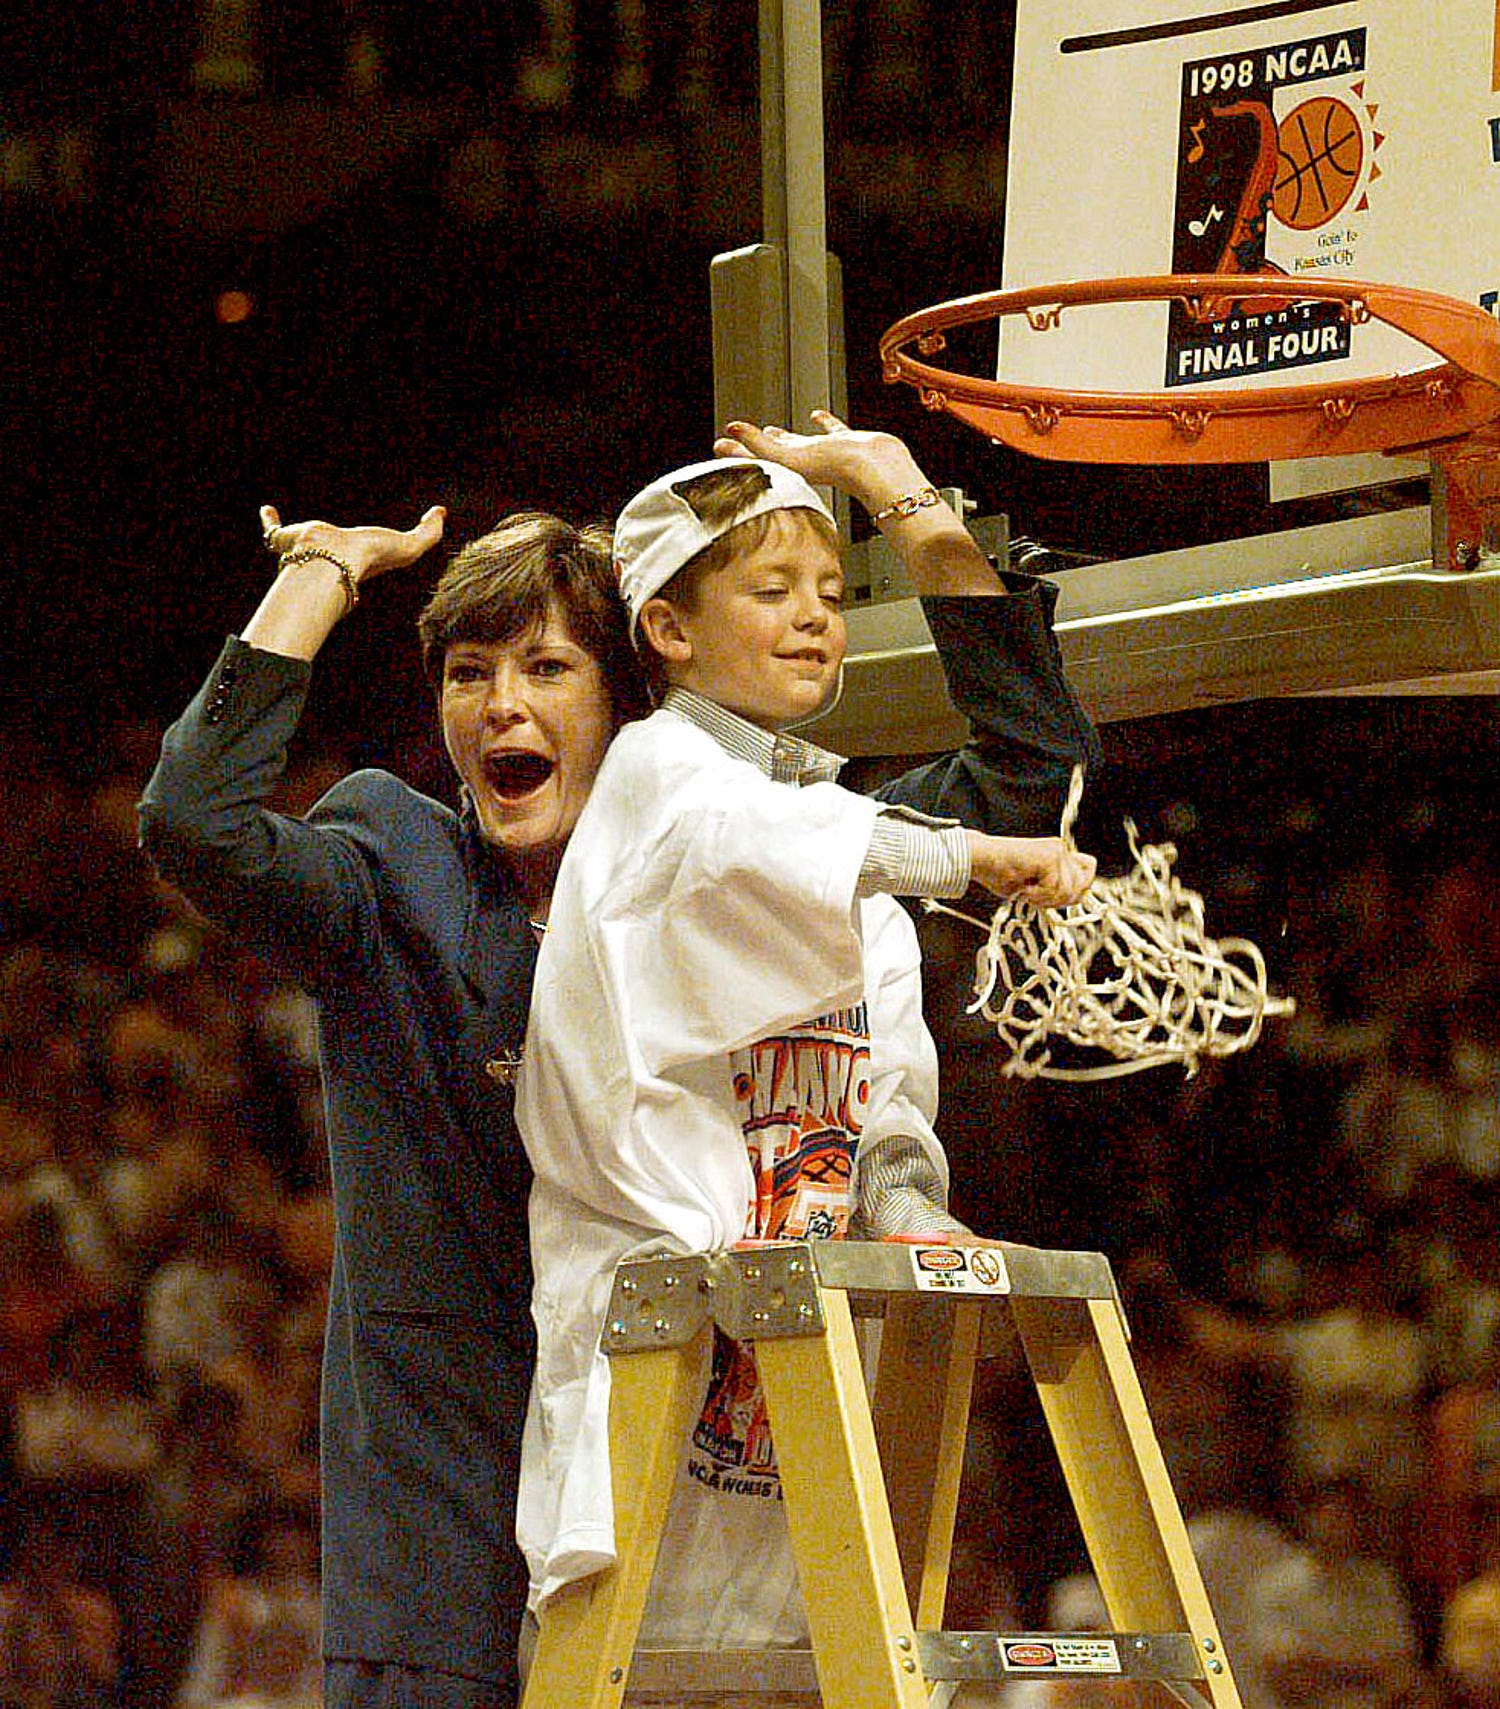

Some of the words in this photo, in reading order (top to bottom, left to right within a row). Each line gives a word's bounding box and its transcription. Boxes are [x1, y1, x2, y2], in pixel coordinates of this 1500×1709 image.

[1190, 59, 1254, 97] 1998
[1212, 307, 1310, 334] women's
[1178, 339, 1260, 377] FINAL
